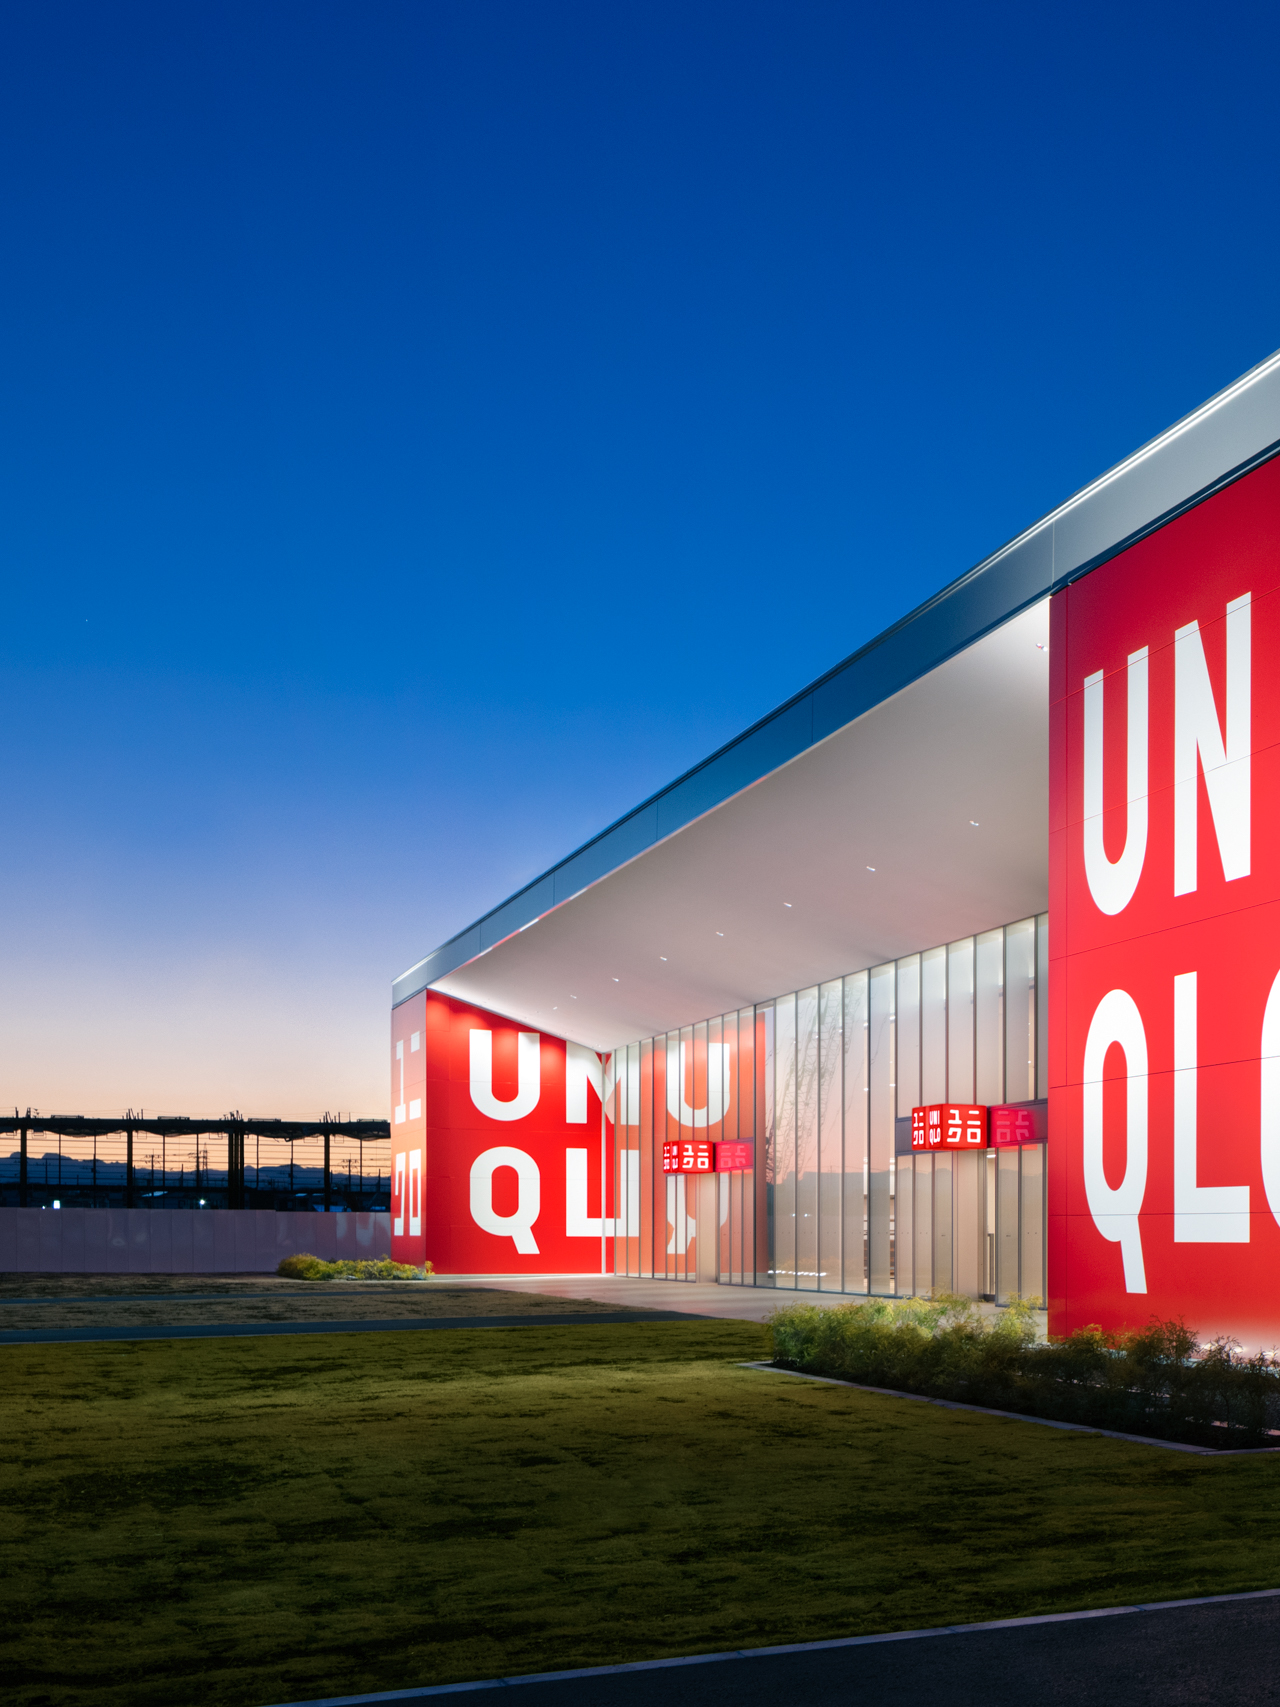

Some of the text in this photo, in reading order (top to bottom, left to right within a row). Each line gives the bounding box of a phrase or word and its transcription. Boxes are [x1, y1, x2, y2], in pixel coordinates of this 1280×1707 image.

[929, 1110, 941, 1126] UNI
[948, 1109, 982, 1125] ユニ
[929, 1127, 941, 1146] QLO
[947, 1127, 982, 1143] クロ
[683, 1145, 709, 1156] ユニ
[682, 1157, 709, 1169] クロ
